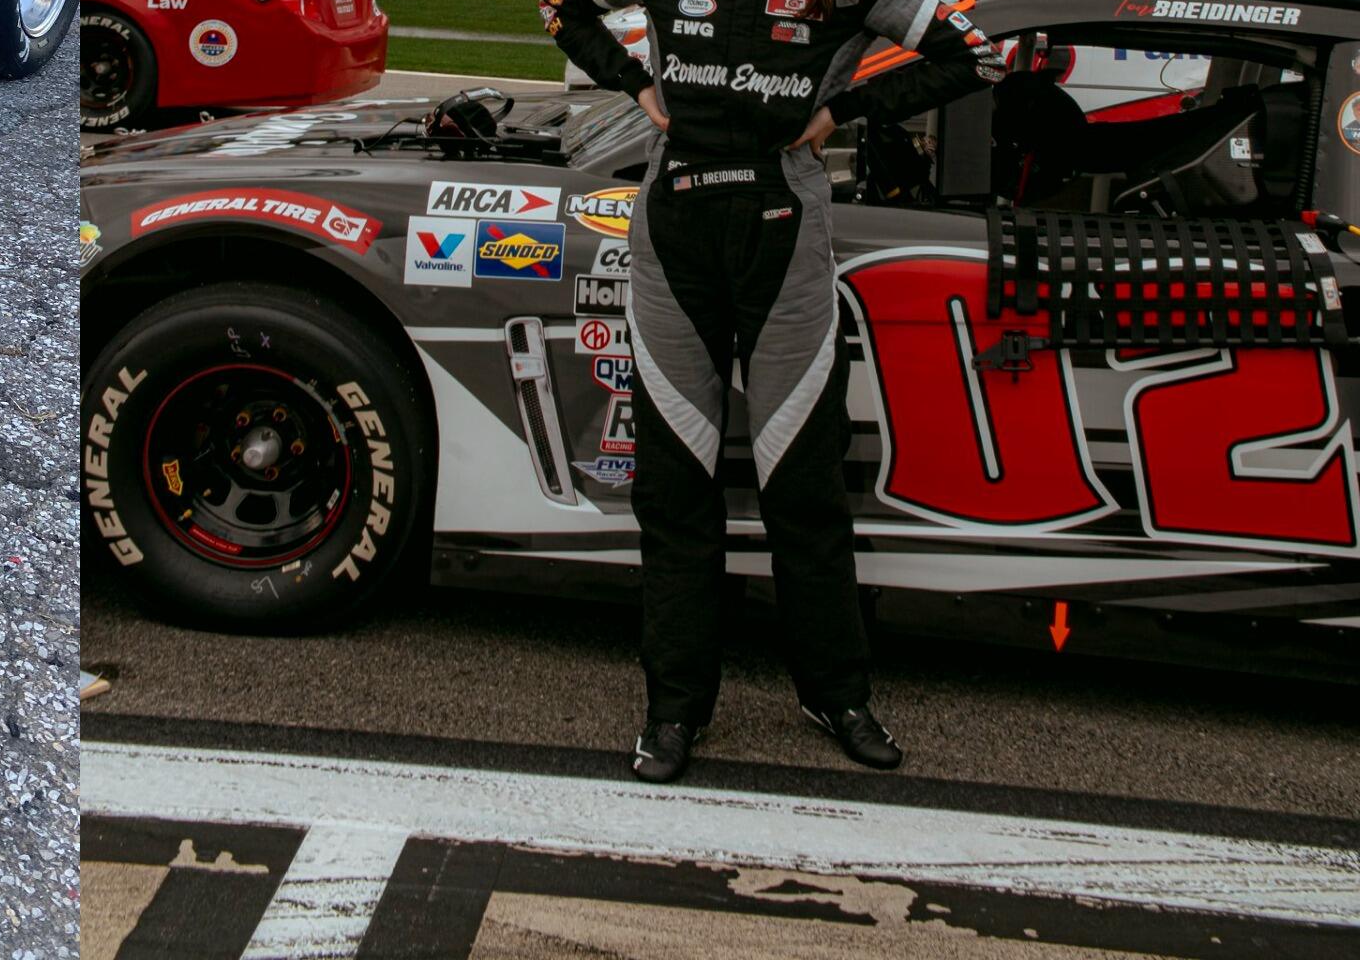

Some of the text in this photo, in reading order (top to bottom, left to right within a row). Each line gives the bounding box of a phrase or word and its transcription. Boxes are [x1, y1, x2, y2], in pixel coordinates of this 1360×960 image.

[1152, 0, 1302, 25] BREIDINGER
[80, 15, 132, 41] NERAL
[672, 19, 715, 38] EWG
[662, 53, 813, 104] Roman Empire
[80, 106, 131, 128] GENE
[693, 169, 756, 187] T. BREIDINGER
[140, 197, 258, 227] GENERAL
[261, 200, 321, 224] TIRE
[432, 186, 512, 214] ARCA
[483, 243, 555, 260] SUNOCO
[414, 259, 464, 272] Valvoline
[578, 279, 630, 307] Holl
[605, 442, 633, 450] RACING
[85, 366, 149, 567] GENERAL
[596, 460, 636, 470] FIVE
[332, 381, 395, 582] GENERAL
